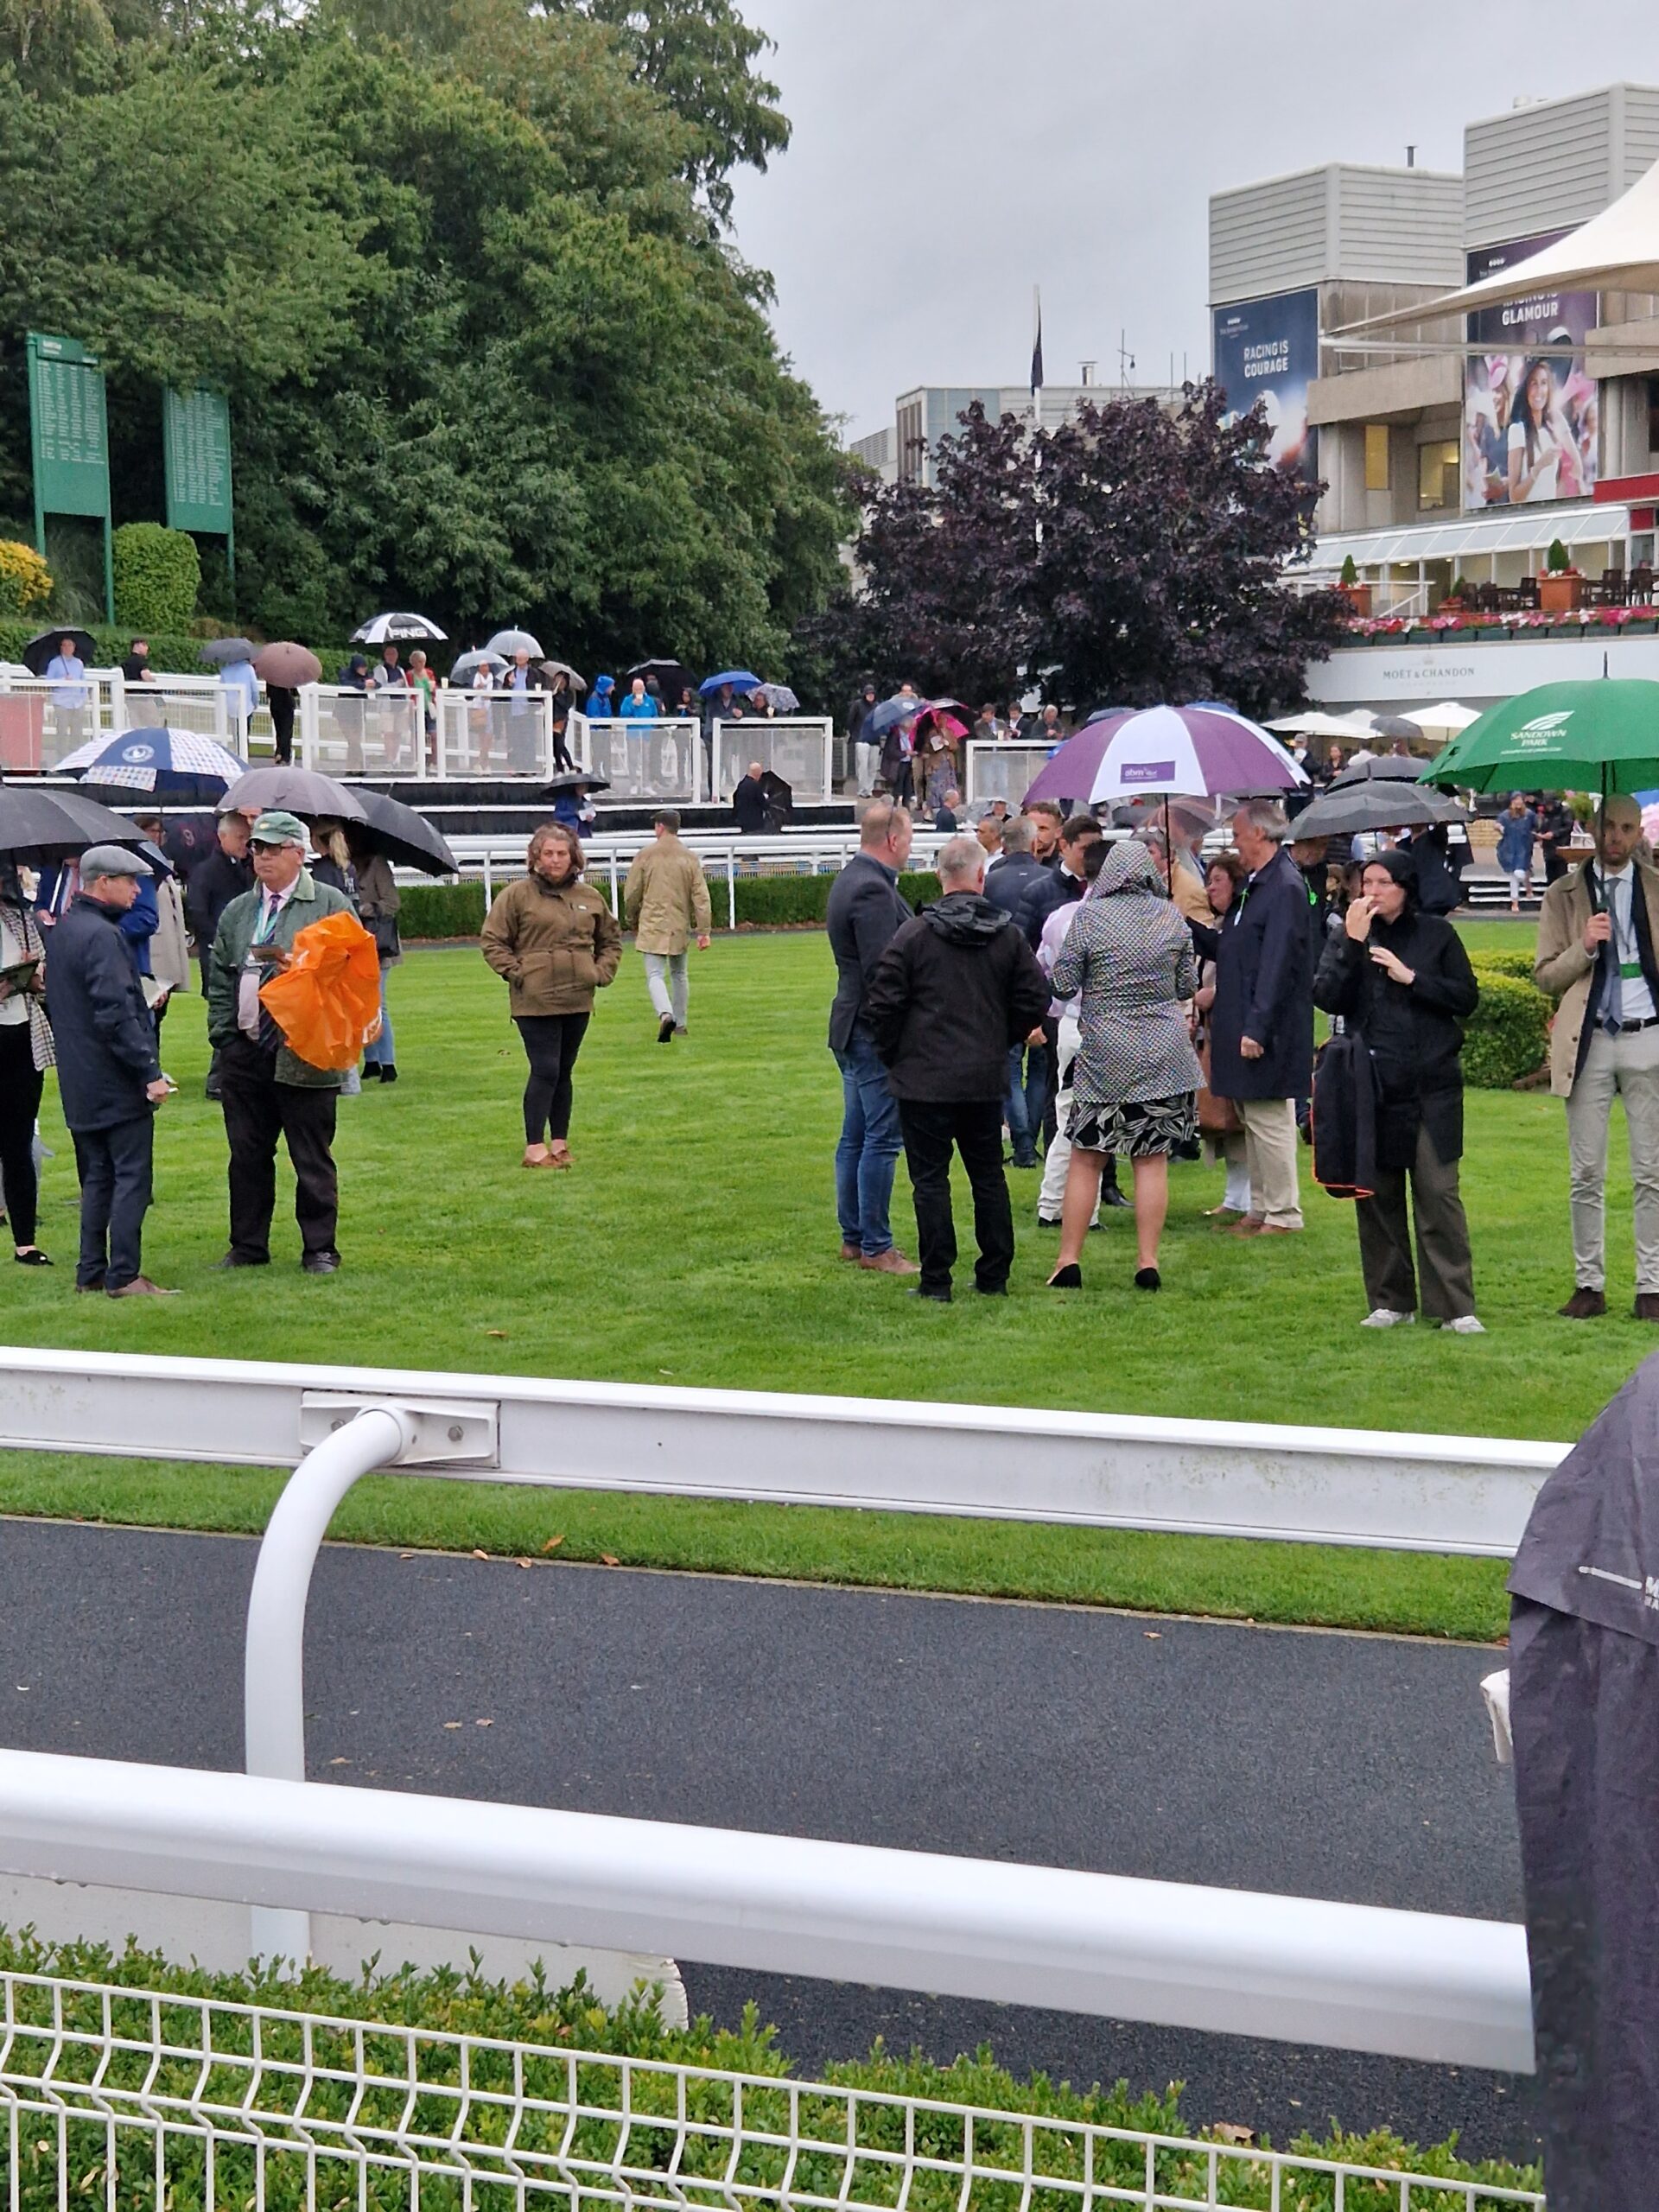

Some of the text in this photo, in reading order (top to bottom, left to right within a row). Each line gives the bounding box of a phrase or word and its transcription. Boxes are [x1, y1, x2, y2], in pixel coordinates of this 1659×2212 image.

[1502, 302, 1558, 326] GLAMOUR
[1244, 340, 1288, 361] RACING IS
[1244, 357, 1288, 378] COURAGE
[389, 626, 429, 639] PING
[1421, 667, 1475, 678] CHANDON
[1510, 729, 1567, 740] SANDOWN
